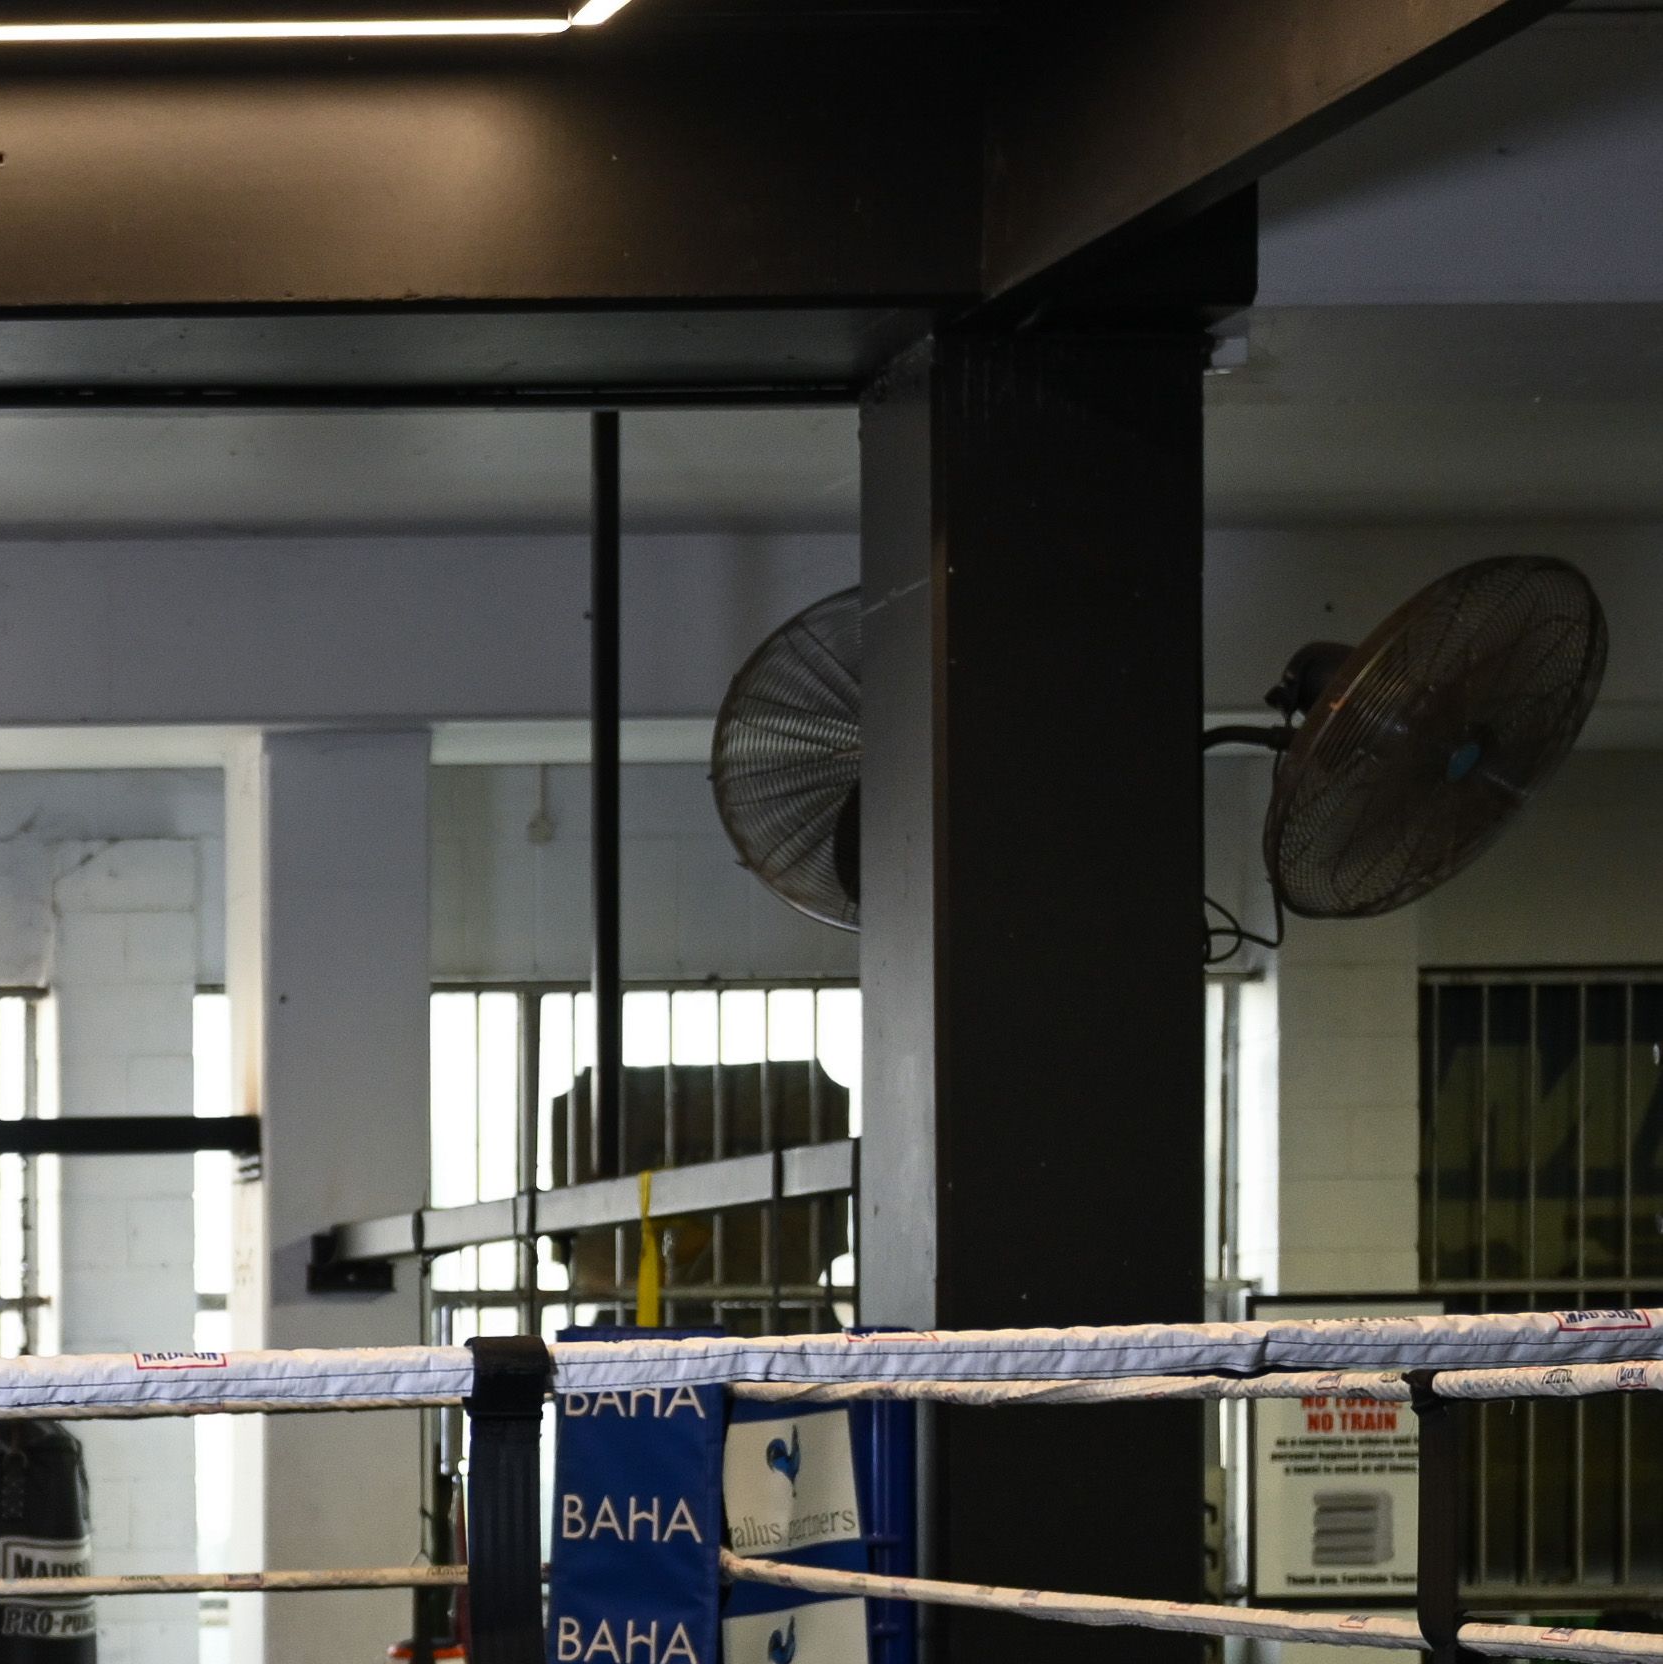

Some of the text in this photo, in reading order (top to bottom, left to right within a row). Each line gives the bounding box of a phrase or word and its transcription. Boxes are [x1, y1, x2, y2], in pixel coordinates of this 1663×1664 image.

[565, 1386, 705, 1419] BAHA
[1308, 1412, 1397, 1431] NO TRAIN
[563, 1494, 701, 1544] BAHA
[788, 1507, 856, 1548] partners
[12, 1551, 89, 1579] MADIS
[3, 1607, 95, 1637] PRO-PUN
